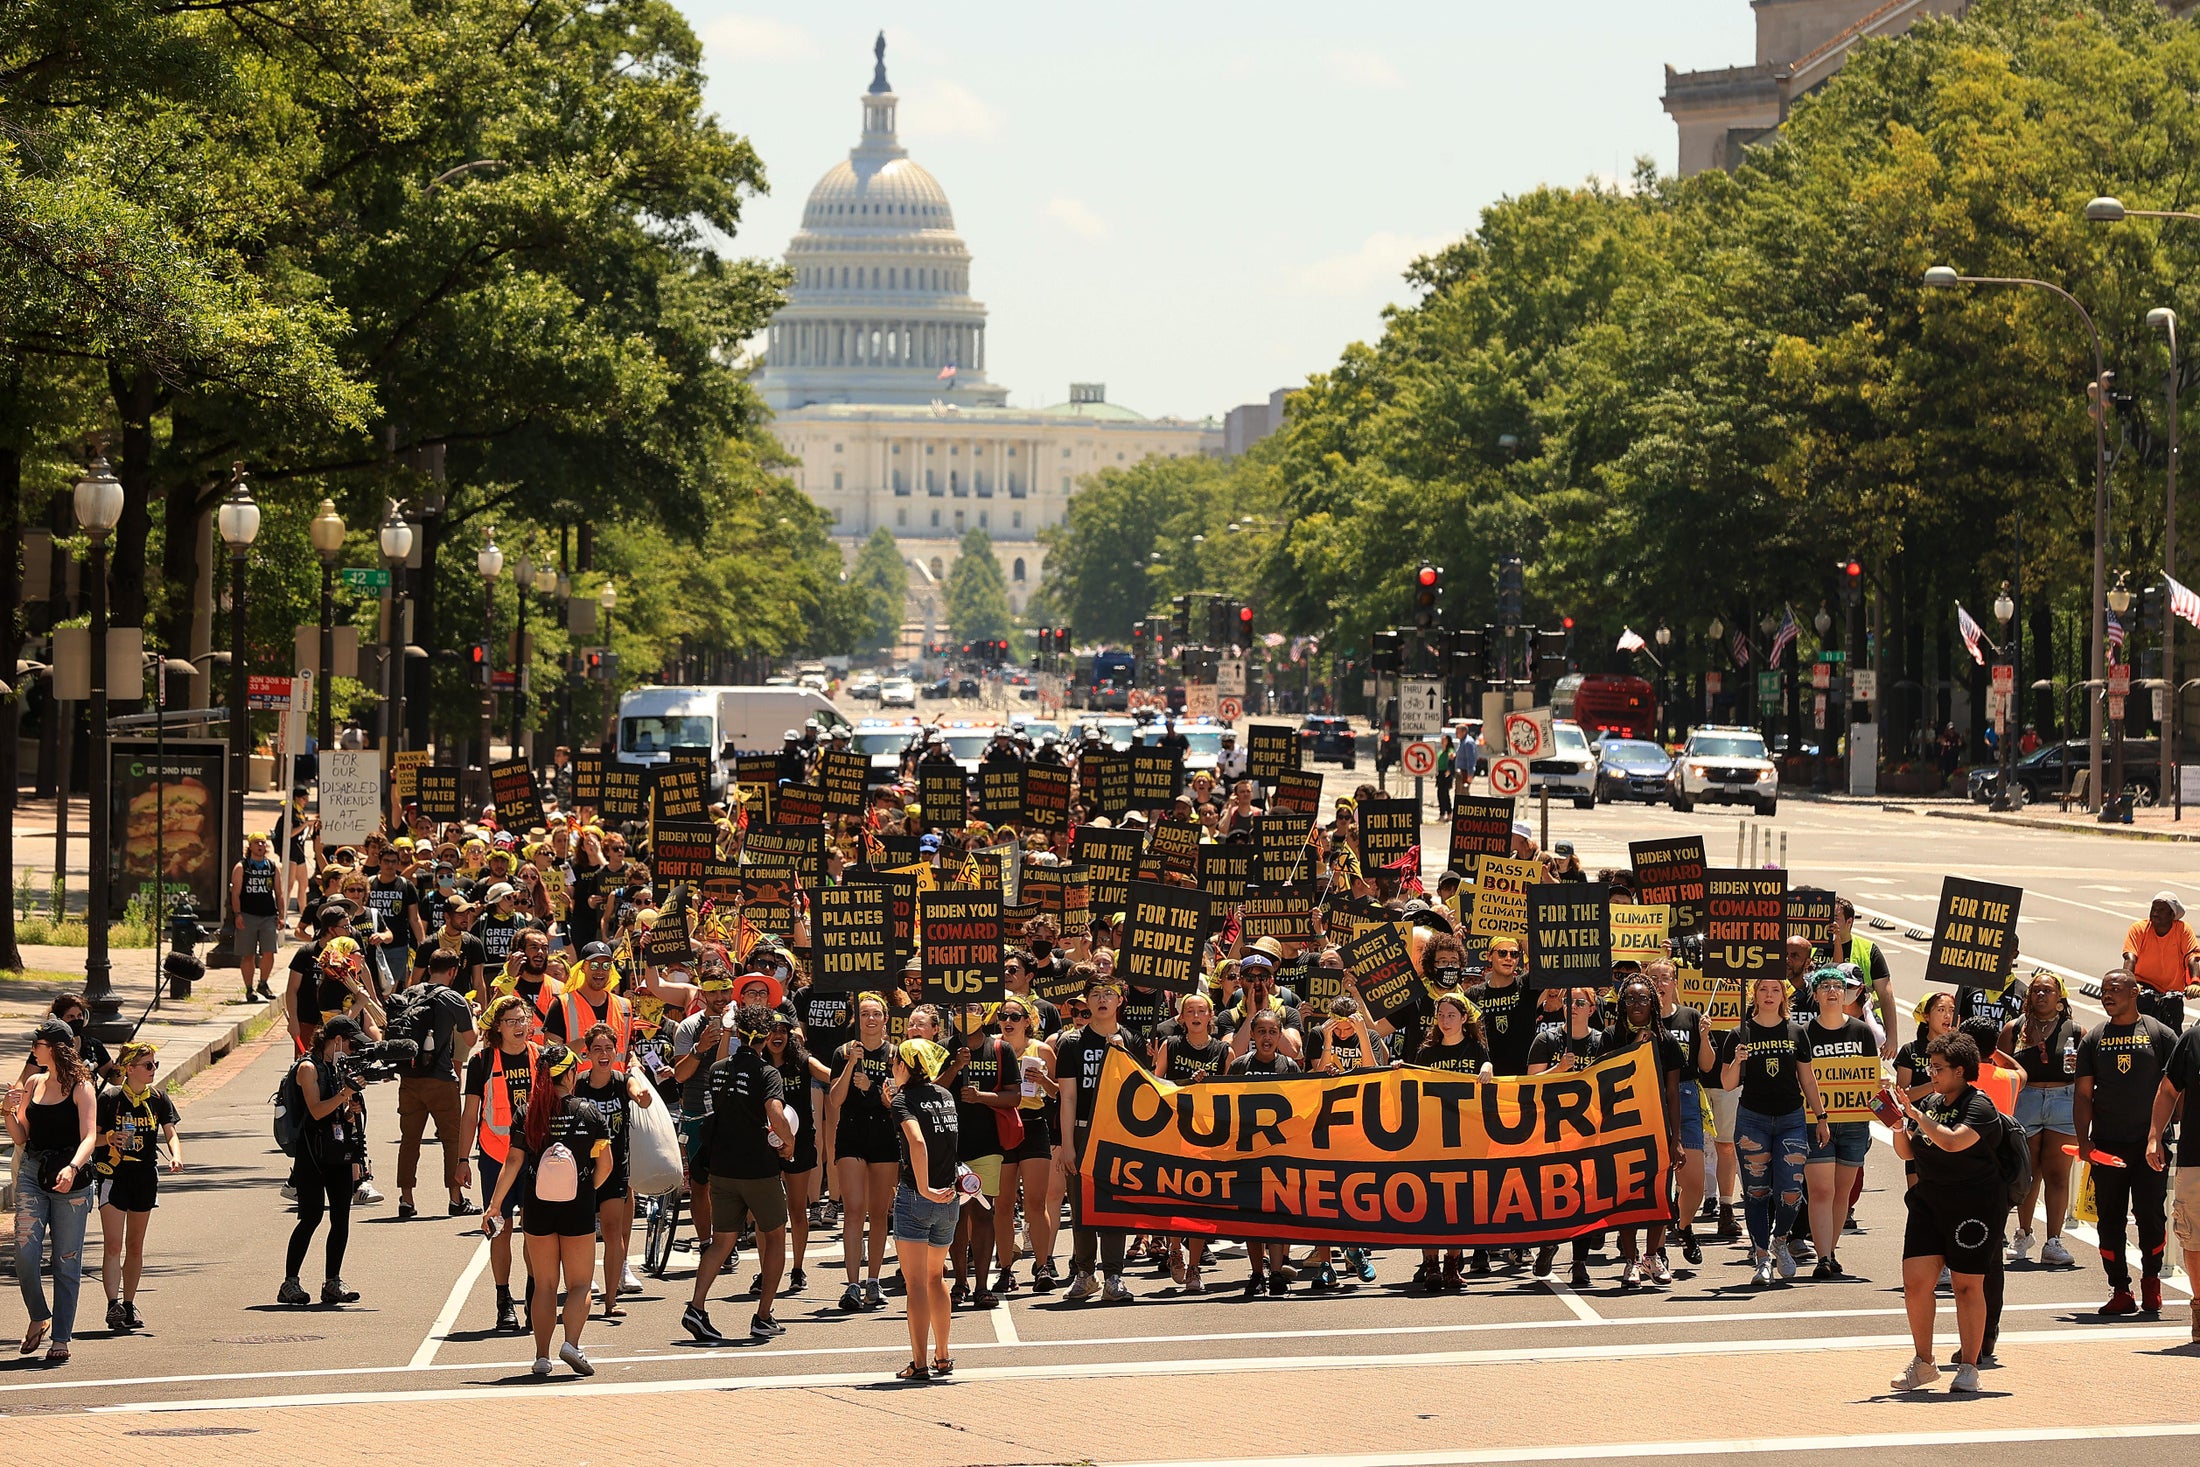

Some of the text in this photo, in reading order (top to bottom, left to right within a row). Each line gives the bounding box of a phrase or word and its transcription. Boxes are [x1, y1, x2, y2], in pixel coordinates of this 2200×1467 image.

[1403, 685, 1422, 693] THRU
[1402, 712, 1440, 722] OBEY THIS
[1402, 723, 1426, 731] SIGNAL
[333, 753, 359, 767] FOR
[1135, 758, 1173, 770] FOR THE
[1253, 751, 1286, 763] PEOPLE
[147, 767, 202, 775] BEOND MEAT
[333, 767, 359, 777] OUR
[827, 769, 864, 779] PLACES
[606, 772, 639, 785] FOR THE
[926, 777, 961, 789] FOR THE
[1134, 772, 1171, 786] WATER
[1280, 775, 1320, 788] BIDEN YOU
[323, 781, 377, 794] DISABLED
[605, 787, 639, 800] PEOPLE
[663, 787, 699, 802] AIR WE
[985, 787, 1019, 799] WATER
[1133, 787, 1170, 799] WE DRINK
[1278, 787, 1318, 799] COWARD
[330, 795, 374, 805] FRIENDS
[422, 791, 455, 801] WATER
[927, 794, 961, 805] PEOPLE
[422, 804, 433, 812] WE
[604, 801, 637, 814] WE LOVE
[665, 801, 702, 816] BREATHE
[781, 800, 821, 813] COWARD
[985, 800, 1020, 810] WE DRINK
[340, 809, 357, 819] AT
[927, 809, 961, 821] WE LOVE
[325, 819, 366, 831] HOME
[1456, 820, 1508, 834] COWARD
[1157, 826, 1199, 844] BIDEN
[1368, 833, 1413, 849] PEOPLE
[1454, 835, 1506, 852] FIGHT FOR
[658, 845, 711, 859] COWARD
[1083, 843, 1134, 862] FOR THE
[1636, 847, 1699, 865] BIDEN YOU
[1166, 855, 1191, 867] PILAS
[1206, 859, 1247, 874] FOR THE
[705, 866, 714, 875] DC
[745, 869, 791, 879] DC DEMANDS
[1024, 870, 1032, 879] DC
[1263, 866, 1309, 881] HOME
[1485, 861, 1536, 878] PASS A
[1639, 864, 1702, 883] COWARD
[1063, 873, 1071, 882] DC
[246, 886, 268, 894] DEAL
[370, 891, 403, 899] GREEN
[1098, 885, 1128, 904] LOVE
[1642, 883, 1704, 905] FIGHT FOR
[1709, 881, 1781, 895] BIDEN YOU
[370, 899, 391, 908] NEW
[821, 889, 883, 905] FOR THE
[926, 903, 997, 918] BIDEN YOU
[1246, 898, 1309, 914] DEFUND MPD
[1539, 904, 1599, 922] FOR THE
[1710, 900, 1781, 917] COWARD
[1949, 895, 2010, 923] FOR THE
[744, 908, 767, 919] GOOD
[769, 908, 791, 918] JOBS
[822, 910, 884, 926] PLACES
[1137, 903, 1199, 930] FOR THE
[1615, 913, 1663, 924] CLIMATE
[486, 928, 518, 938] GREEN
[927, 923, 997, 941] COWARD
[1246, 918, 1311, 935] REFUND DC
[1479, 918, 1528, 935] CORPS
[1709, 922, 1780, 940] FIGHT FOR
[1814, 925, 1830, 940] DC
[486, 937, 511, 945] NEW
[823, 931, 883, 947] WE CALL
[1132, 929, 1195, 955] PEOPLE
[1538, 929, 1601, 948] WATER
[1621, 933, 1661, 949] DEAL
[1945, 923, 2004, 948] AIR WE
[651, 943, 686, 954] CORPS
[1352, 932, 1387, 960] MEET
[824, 952, 885, 972] HOME
[927, 945, 997, 965] FIGHT FOR
[1351, 942, 1403, 976] WITH US
[1539, 953, 1601, 969] WE DRINK
[1940, 946, 1999, 973] BREATHE
[1130, 953, 1191, 981] WE LOVE
[1365, 970, 1414, 1003] CORRUPT
[810, 1000, 847, 1010] GREEN
[1383, 988, 1410, 1010] GOP
[1479, 992, 1520, 1009] SUNRISE
[808, 1008, 833, 1018] NEW
[1972, 1005, 2004, 1018] NEW
[808, 1018, 836, 1028] DEAL
[1747, 1039, 1795, 1052] SUNRISE
[2100, 1035, 2150, 1046] SUNRISE
[634, 1043, 662, 1053] NEW
[1812, 1041, 1863, 1057] GREEN
[1174, 1054, 1219, 1072] SUNRISE
[1825, 1066, 1875, 1081] CLIMATE
[1116, 1060, 1643, 1152] OUR FUTURE
[1833, 1090, 1872, 1108] DEAL
[1111, 1148, 1647, 1226] IS NOT NEGOTIABLE
